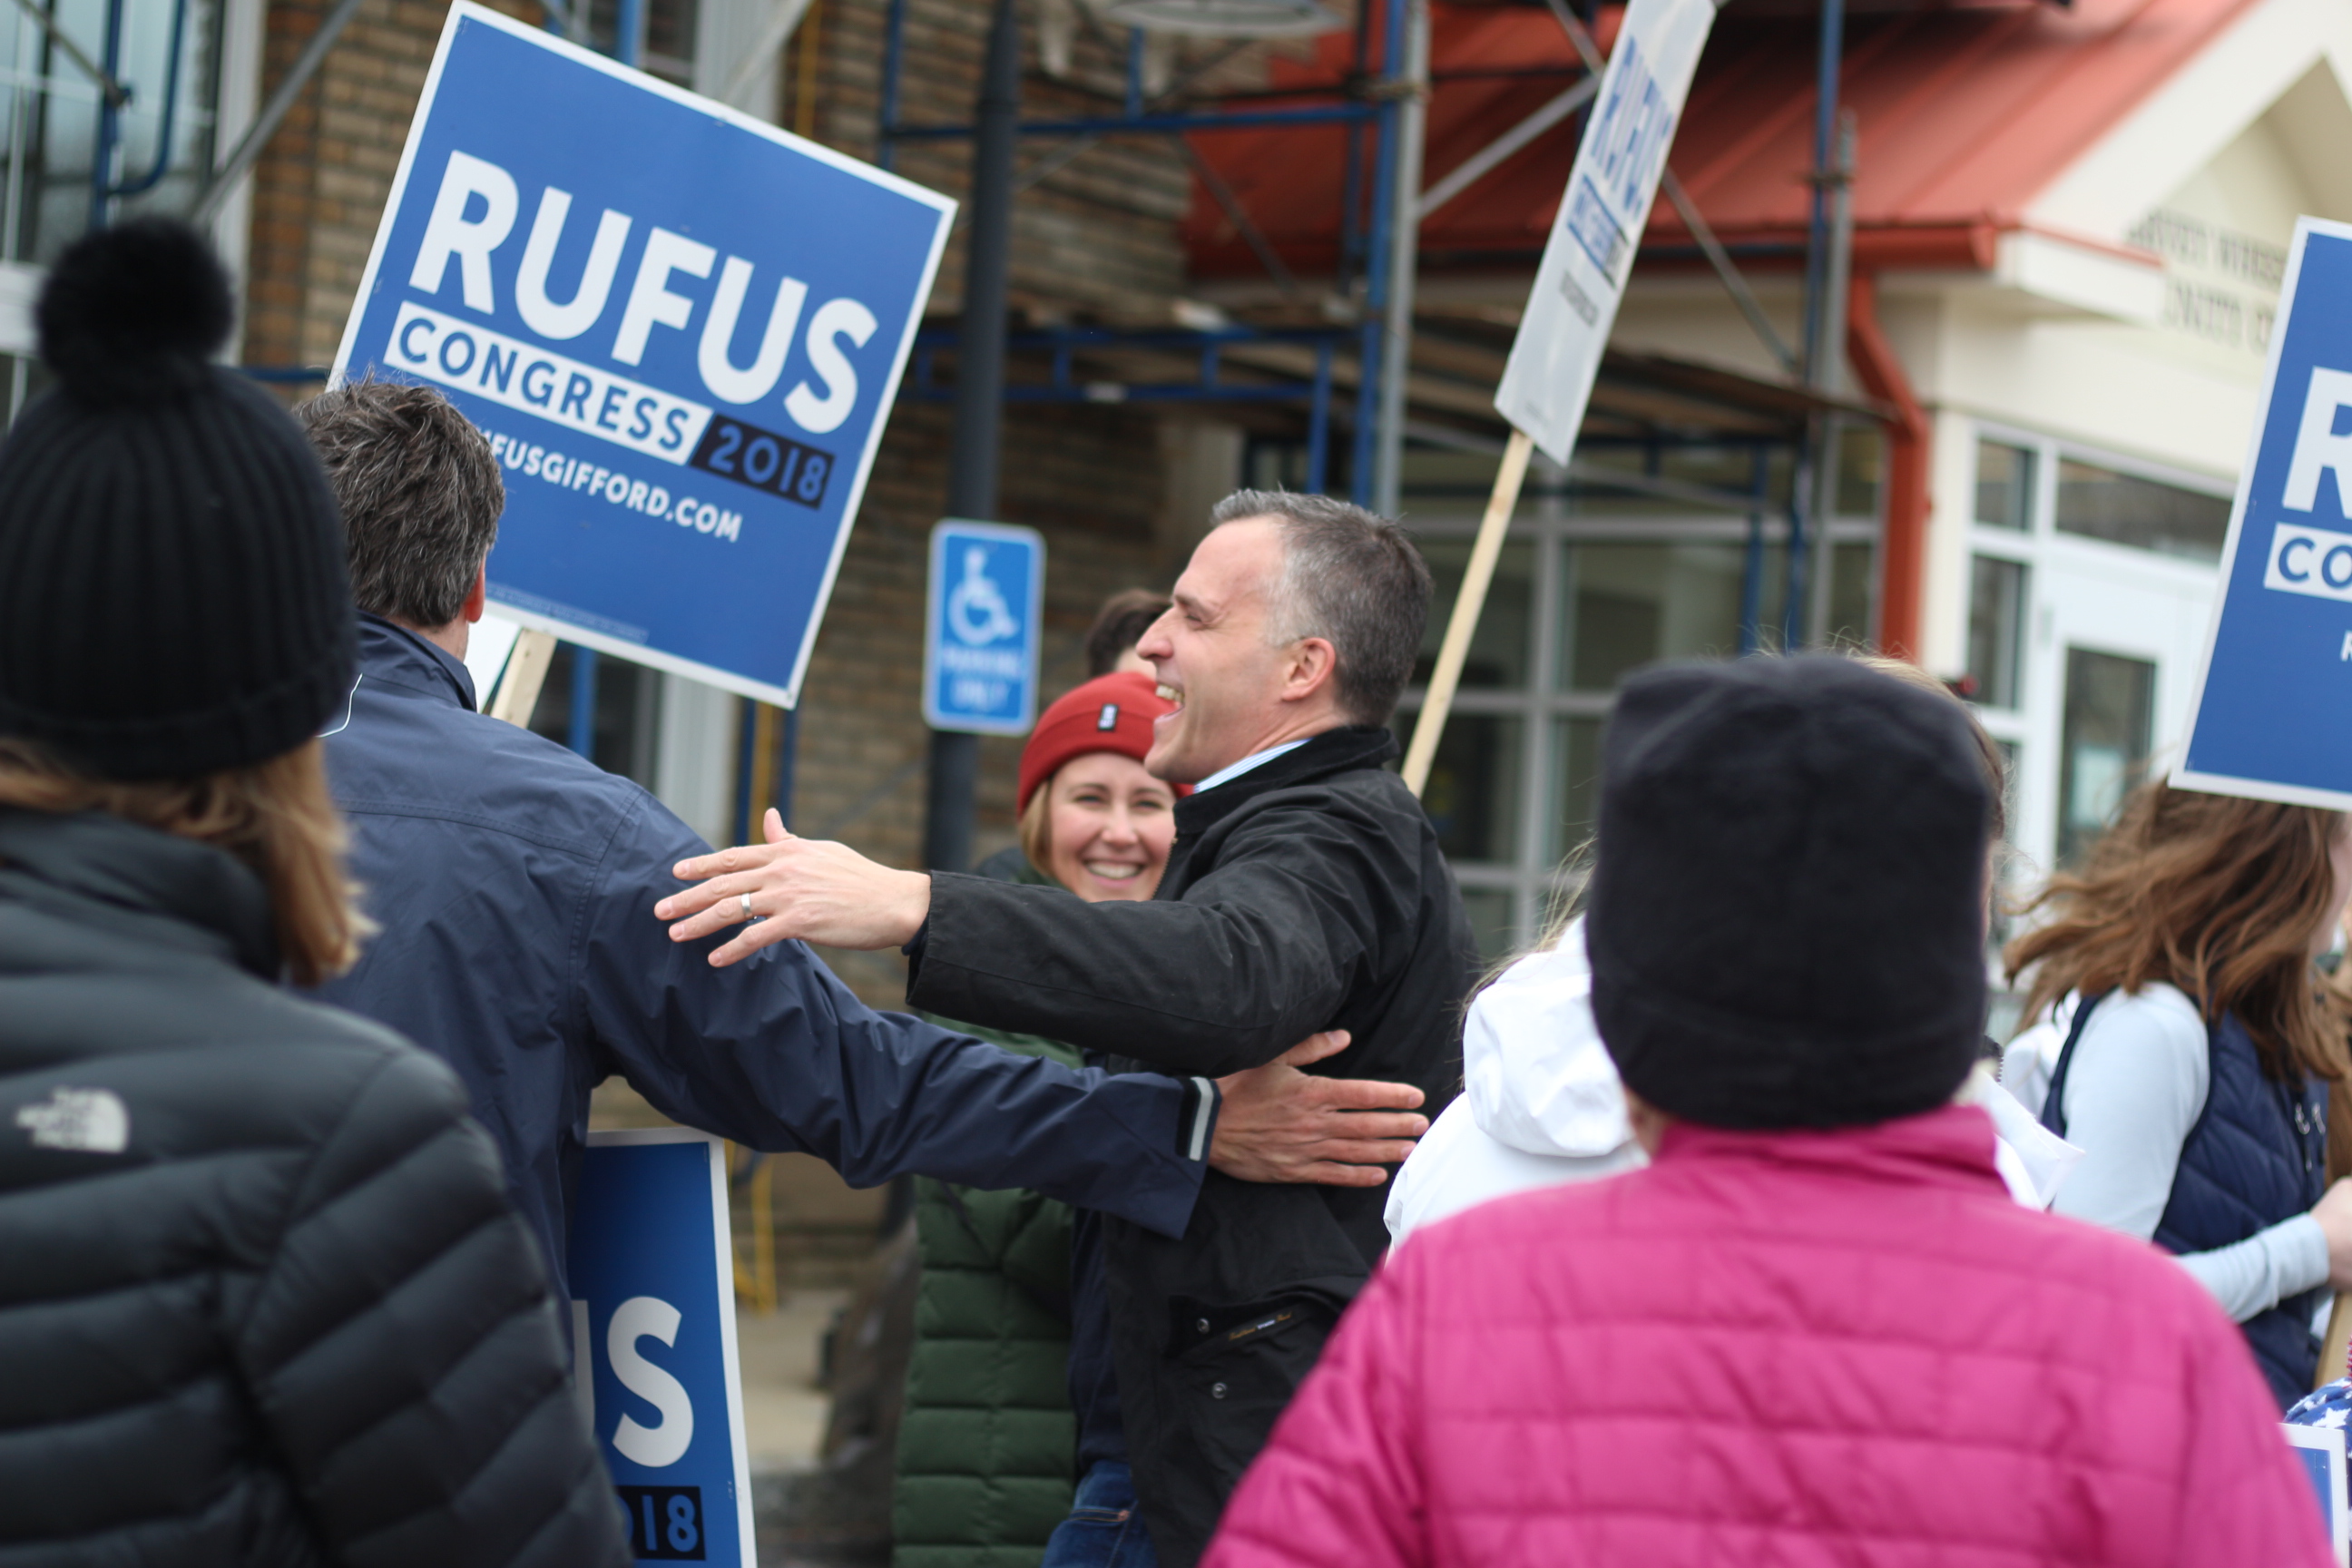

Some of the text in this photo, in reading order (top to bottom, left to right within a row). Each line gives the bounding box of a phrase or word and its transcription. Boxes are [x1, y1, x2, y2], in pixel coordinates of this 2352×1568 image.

[409, 150, 878, 434] RUFUS
[398, 318, 826, 500] CONGRESS 2018
